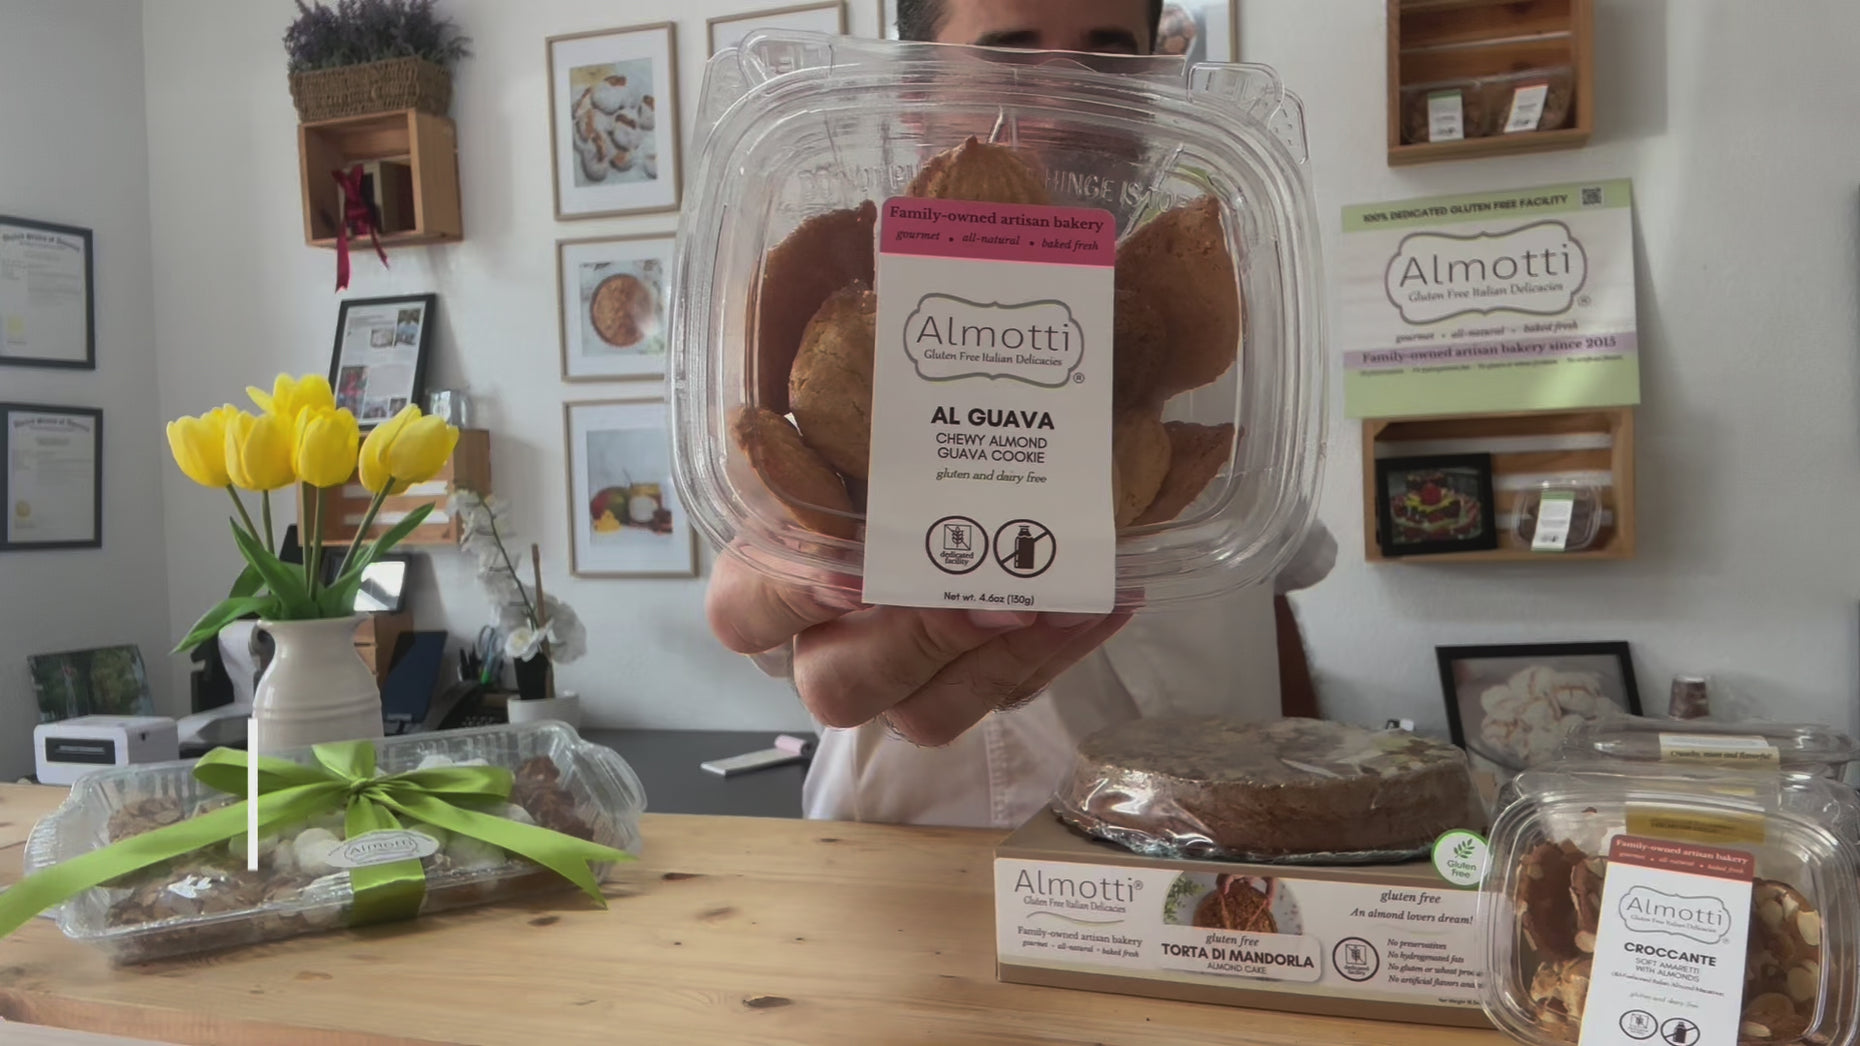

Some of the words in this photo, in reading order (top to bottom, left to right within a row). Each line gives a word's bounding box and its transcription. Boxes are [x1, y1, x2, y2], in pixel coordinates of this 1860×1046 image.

[1045, 169, 1115, 202] HINGE
[1363, 212, 1388, 223] 100%
[1391, 206, 1448, 220] DEDICATED
[1450, 202, 1492, 215] GLUTEN
[1494, 200, 1517, 210] FREE
[1520, 194, 1568, 209] FACILITY
[890, 206, 997, 225] Family-owned
[1001, 214, 1050, 228] artisan
[1054, 216, 1104, 233] bakery
[896, 230, 940, 241] gourmet
[962, 232, 1020, 246] all-natural
[1042, 238, 1071, 251] baked
[1073, 240, 1099, 252] fresh
[1399, 243, 1570, 288] Almotti
[1408, 290, 1444, 303] Gluten
[1447, 288, 1469, 300] Free
[1472, 284, 1507, 298] Italian
[1510, 281, 1563, 296] Delicacies
[916, 315, 1069, 352] Almotti
[924, 348, 957, 361] Gluten
[959, 351, 980, 362] Free
[982, 351, 1013, 364] Italian
[1016, 353, 1062, 366] Delicacies
[1362, 346, 1452, 365] Family-owned
[1455, 342, 1498, 357] artisan
[1501, 339, 1548, 357] bakery
[1550, 337, 1582, 350] since
[931, 406, 961, 425] AL
[968, 408, 1054, 430] GUAVA
[936, 432, 985, 447] CHEWY
[989, 435, 1047, 449] ALMOND
[937, 447, 987, 461] GUAVA
[991, 449, 1045, 464] COOKIE
[936, 468, 970, 481] gluten
[973, 469, 994, 481] and
[997, 471, 1024, 484] dairy
[1026, 471, 1047, 484] free
[940, 550, 974, 559] dedicated
[945, 557, 969, 566] facility
[944, 592, 961, 601] Net
[962, 593, 976, 602] wt.
[979, 593, 1004, 603] 4.6oz
[1616, 839, 1681, 856] Family-owned
[1683, 848, 1714, 860] artisan
[1716, 852, 1748, 864] bakery
[1447, 859, 1477, 872] Gluten
[1451, 868, 1471, 879] Free
[1023, 895, 1048, 907] Gluten
[1049, 898, 1065, 908] Free
[1066, 900, 1089, 910] Italian
[1090, 902, 1126, 913] Delicacies
[1380, 890, 1416, 903] gluten
[1418, 892, 1441, 905] free
[1350, 907, 1366, 917] An
[1368, 909, 1405, 920] almond
[1407, 912, 1435, 922] lovers
[1438, 914, 1473, 925] dream!
[1626, 896, 1722, 926] Almotti
[1017, 926, 1079, 940] Family-owned
[1081, 933, 1111, 943] artisan
[1112, 935, 1143, 947] bakery
[1205, 933, 1237, 945] gluten
[1239, 935, 1260, 947] free
[1387, 938, 1398, 947] No
[1399, 940, 1447, 950] preservatives
[1161, 943, 1208, 959] TORTA
[1212, 948, 1226, 961] DI
[1229, 949, 1315, 969] MANDORLA
[1387, 951, 1399, 959] No
[1400, 951, 1450, 962] hydrogenated
[1450, 955, 1465, 964] fats
[1624, 942, 1717, 967] CROCCANTE
[1207, 961, 1242, 973] ALMOND
[1244, 965, 1267, 974] CAKE
[1388, 963, 1399, 971] No
[1399, 964, 1423, 973] gluten
[1434, 967, 1457, 975] wheat
[1635, 957, 1657, 967] SOFT
[1659, 961, 1700, 974] AMARETTI
[1635, 964, 1656, 975] WITH
[1658, 969, 1700, 983] ALMONDS
[1388, 975, 1400, 983] No
[1400, 976, 1433, 986] artificial
[1432, 978, 1459, 987] flavors
